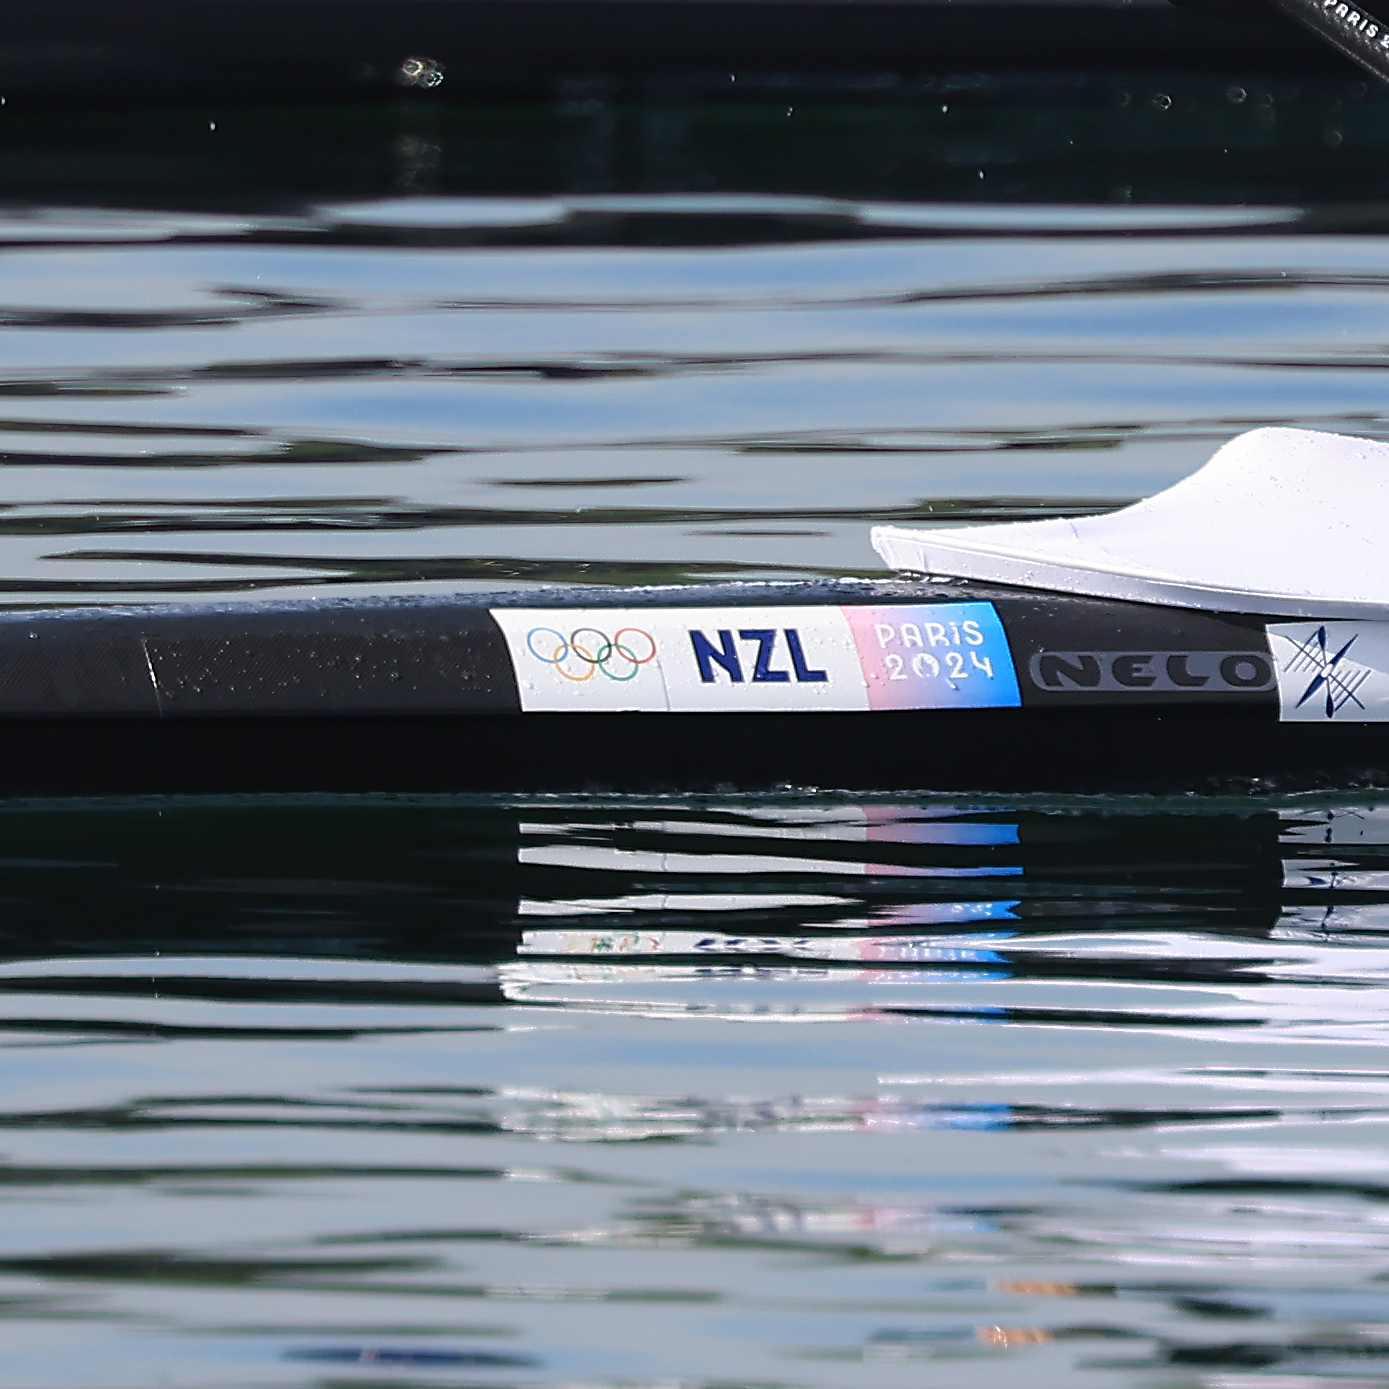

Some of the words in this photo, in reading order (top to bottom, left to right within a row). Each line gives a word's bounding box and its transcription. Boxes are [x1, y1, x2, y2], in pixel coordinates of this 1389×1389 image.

[874, 620, 985, 649] PARIS
[688, 628, 829, 683] NZL
[884, 651, 995, 681] 2024
[1039, 654, 1272, 687] NELO
